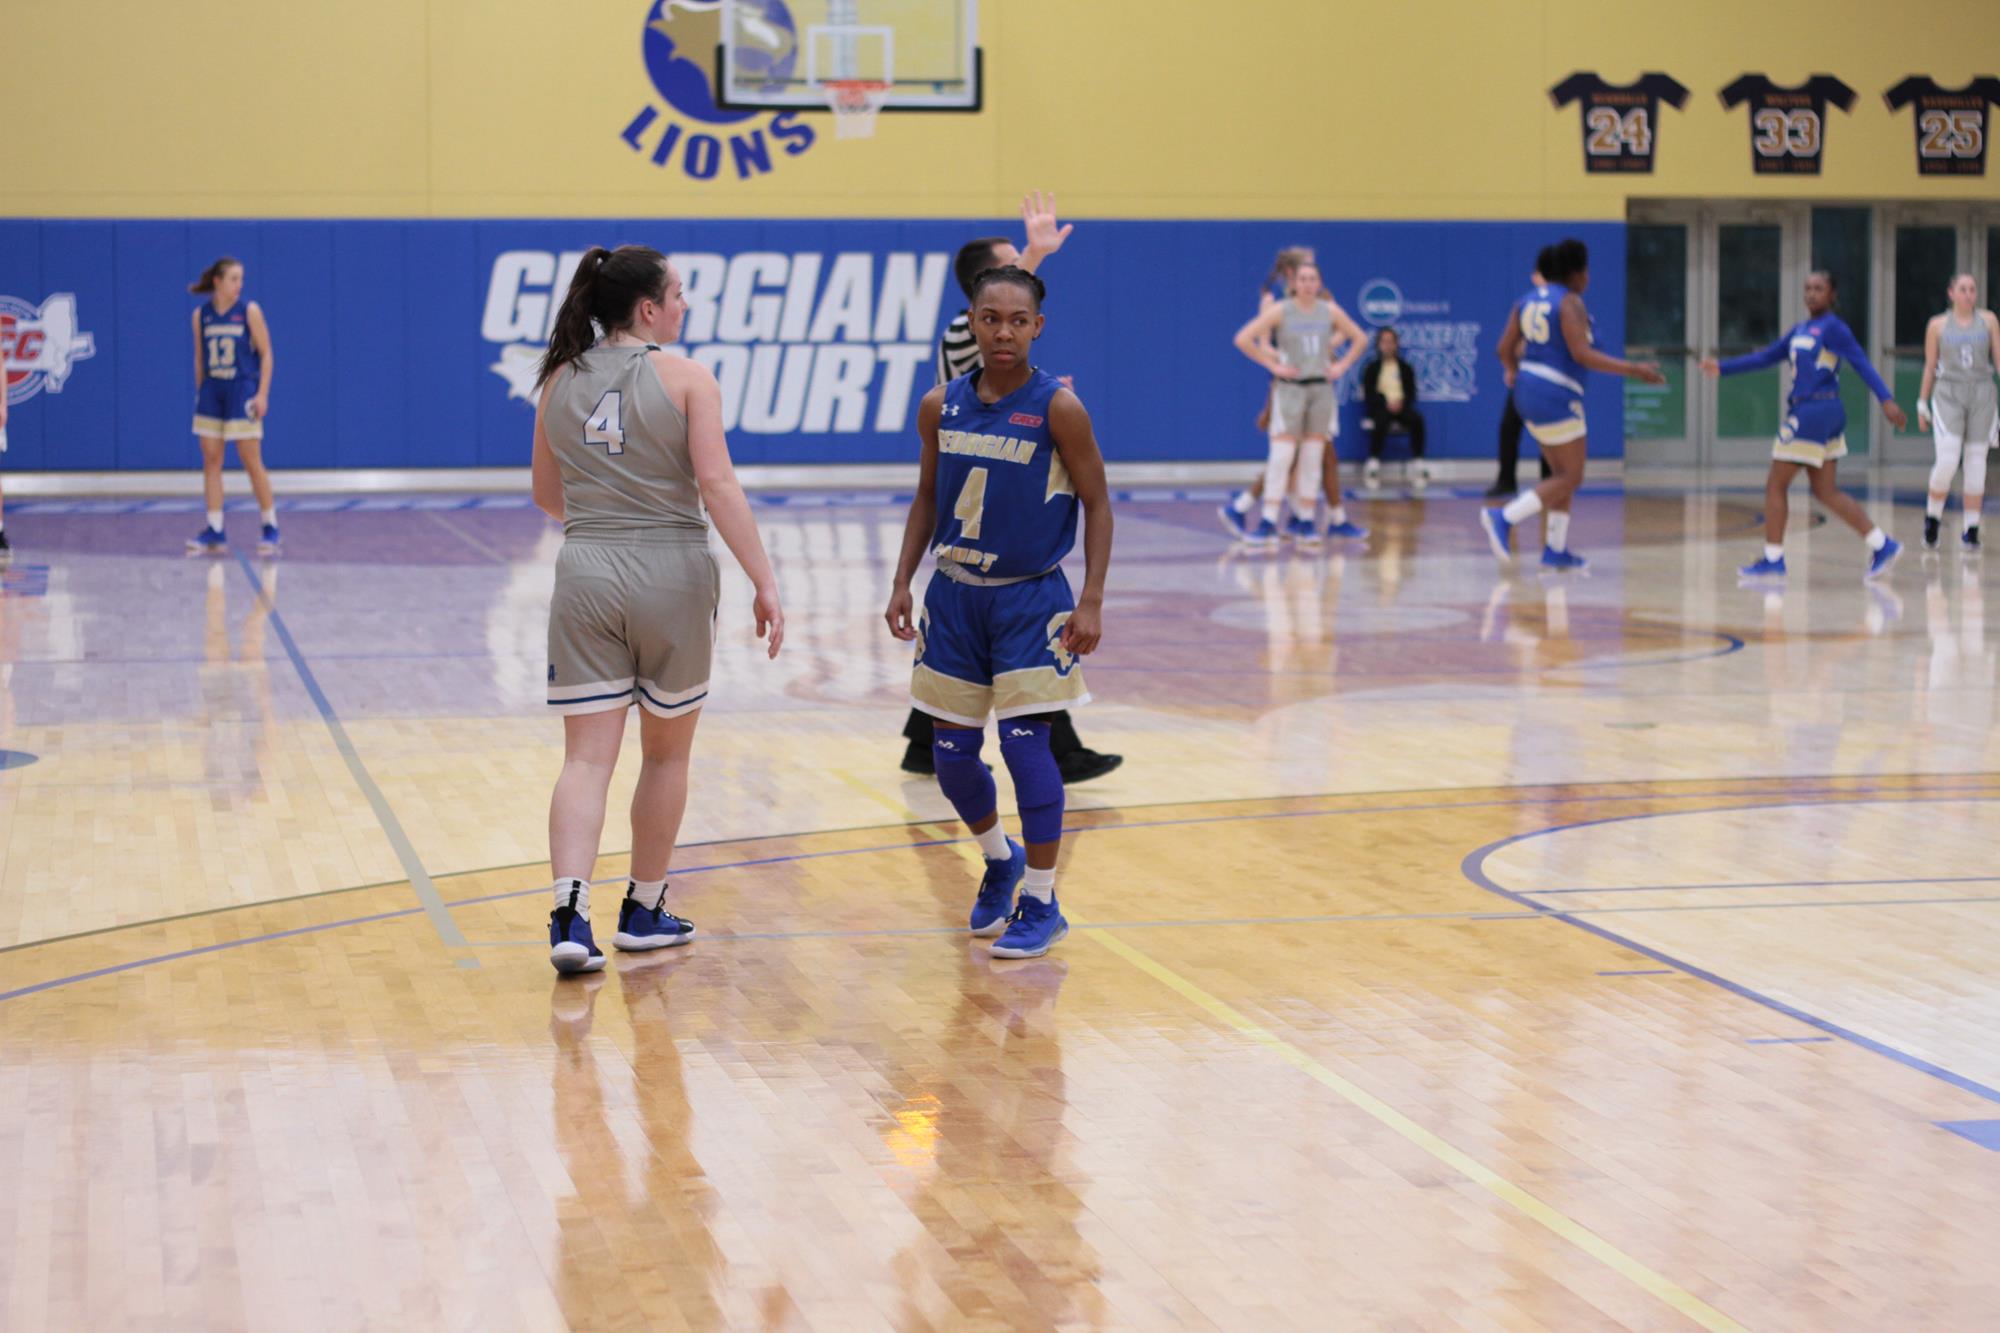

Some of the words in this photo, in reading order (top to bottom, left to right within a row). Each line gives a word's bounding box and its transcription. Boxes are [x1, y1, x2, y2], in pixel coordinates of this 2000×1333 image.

[620, 104, 816, 181] LIONS
[1586, 106, 1652, 156] 24
[1754, 107, 1821, 158] 33
[1920, 109, 1983, 158] 25
[207, 336, 236, 368] 13
[657, 344, 932, 433] OURT
[583, 391, 625, 455] 4
[954, 466, 988, 540] 4
